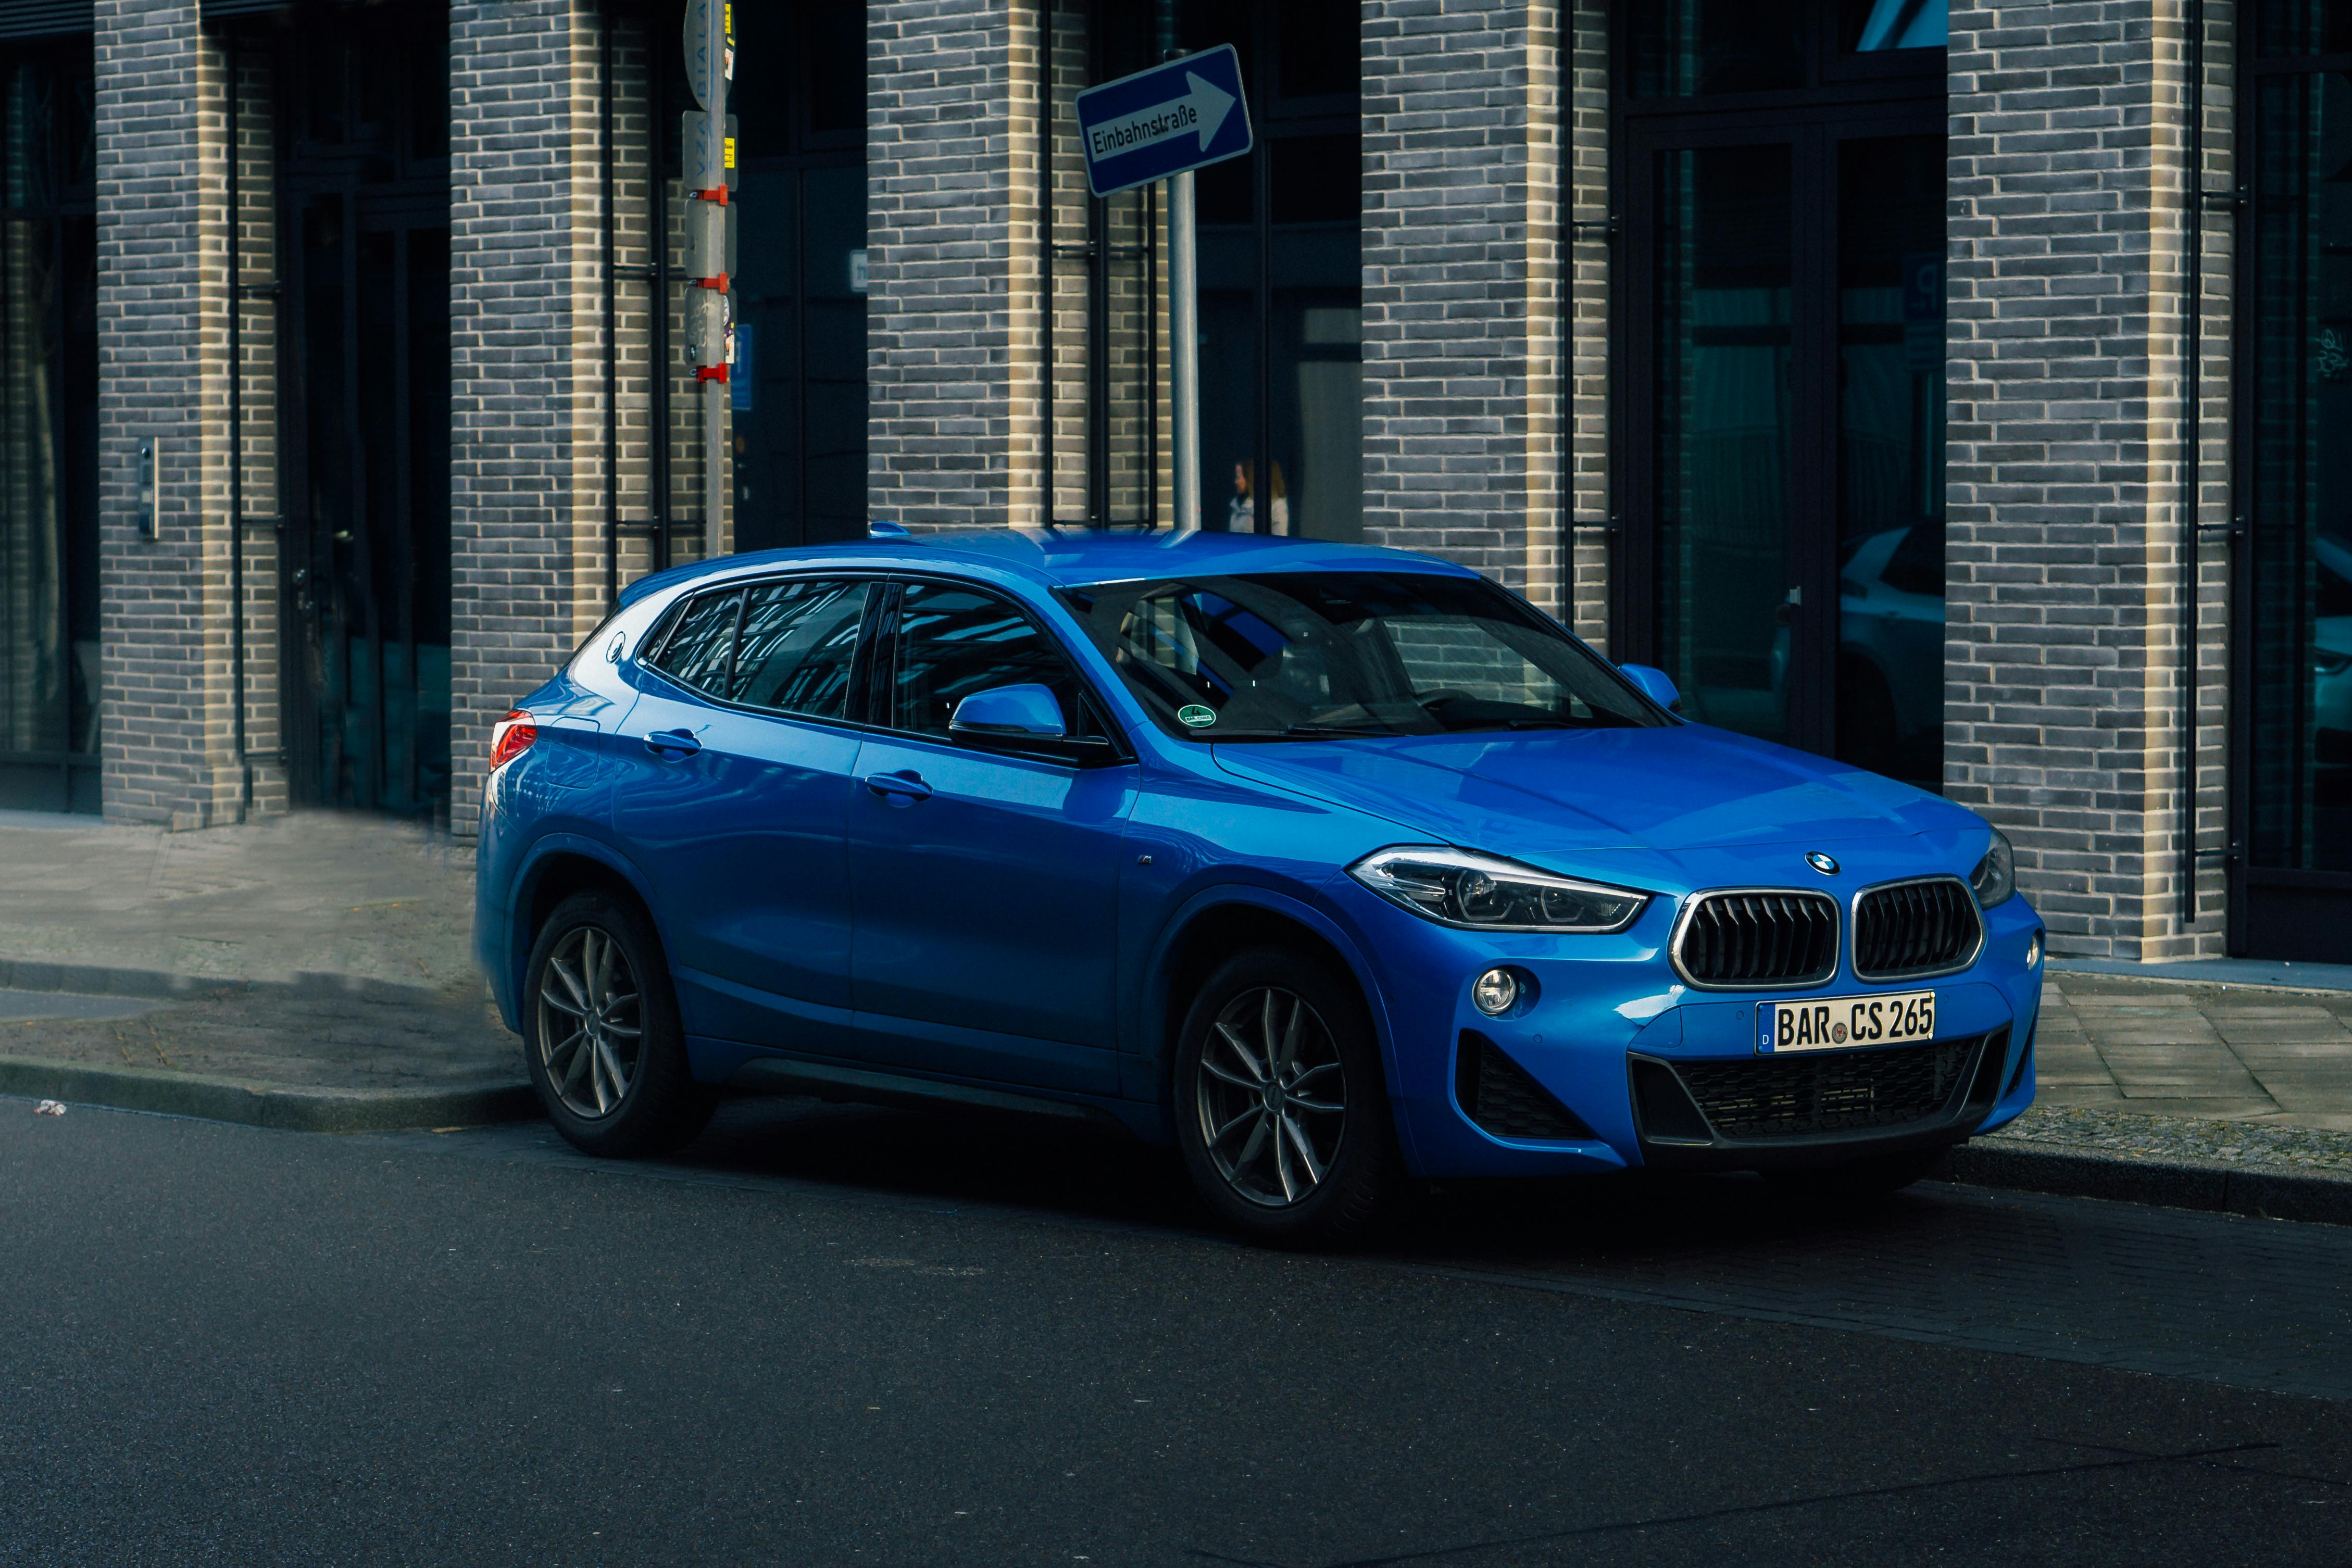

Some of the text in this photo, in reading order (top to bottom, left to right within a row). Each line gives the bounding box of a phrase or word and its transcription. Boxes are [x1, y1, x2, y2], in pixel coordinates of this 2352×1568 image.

[1093, 105, 1197, 154] Einbahnstraße
[1192, 707, 1201, 715] 4
[1778, 997, 1933, 1046] BAR CS 265
[1762, 1034, 1769, 1045] D
